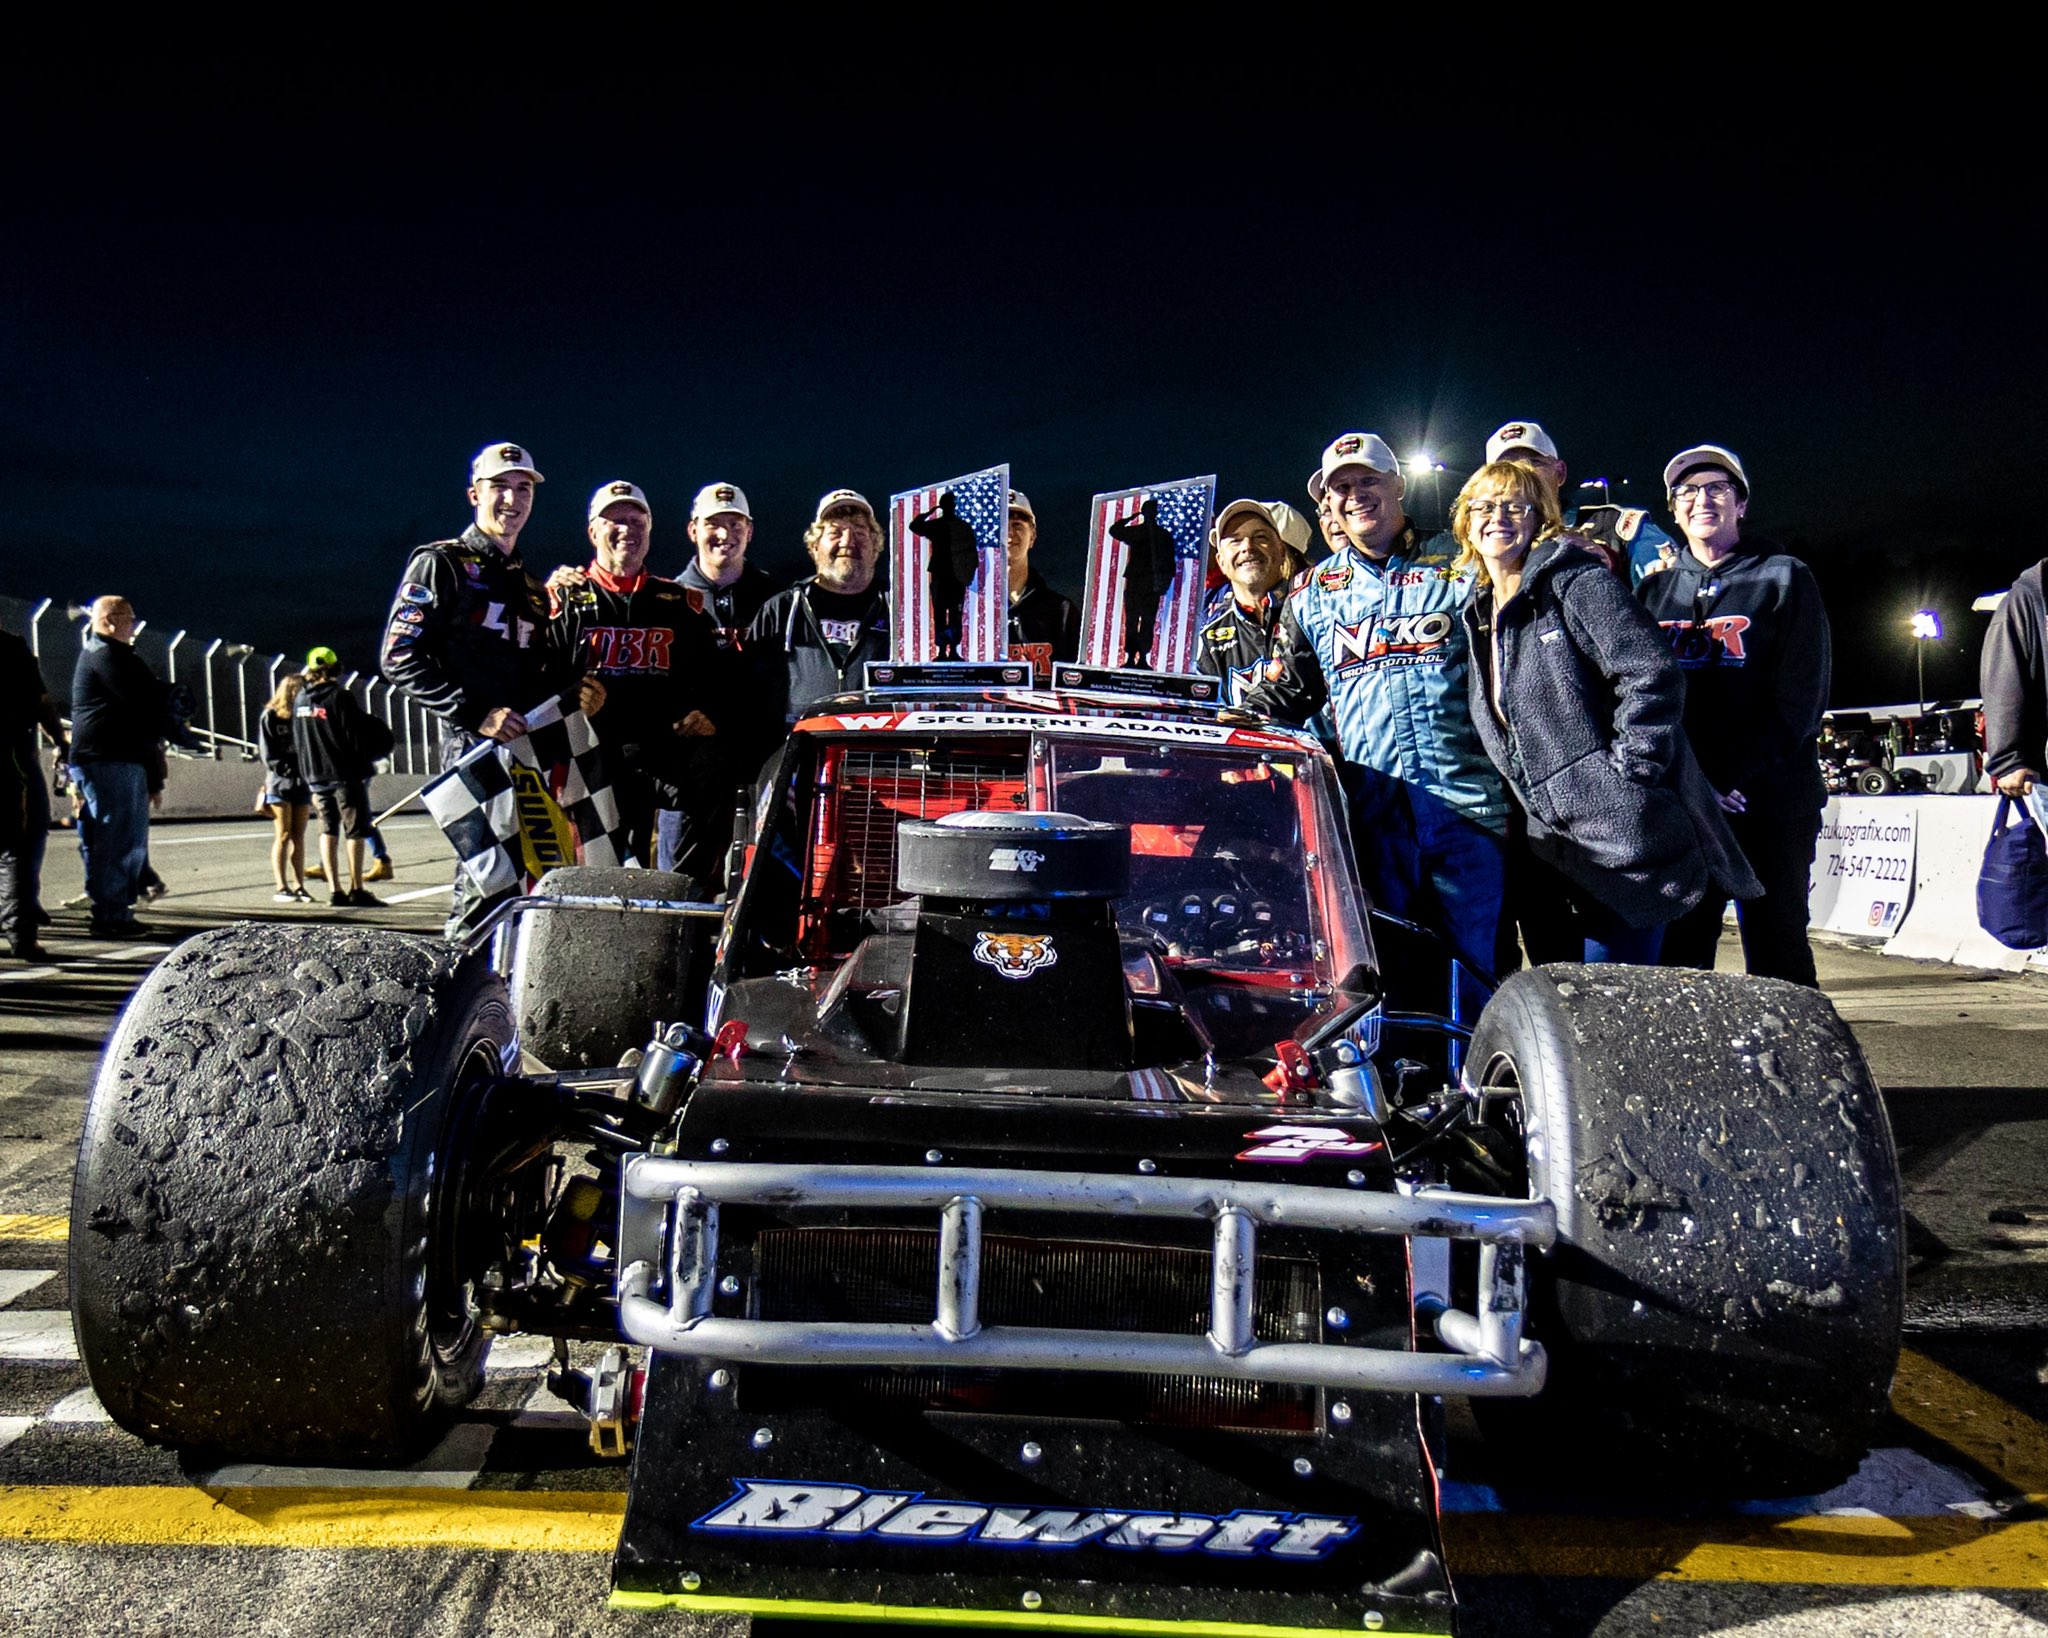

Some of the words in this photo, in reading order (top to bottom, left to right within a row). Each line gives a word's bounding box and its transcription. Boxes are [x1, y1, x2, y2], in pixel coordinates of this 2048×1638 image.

[580, 627, 675, 669] TBR
[1341, 663, 1376, 680] RADIO
[1379, 654, 1445, 669] CONTROL
[917, 715, 975, 725] SFC
[985, 716, 1095, 728] BRENT
[1104, 720, 1223, 738] ADAMS
[1826, 854, 1907, 881] 724-547-2222
[692, 1479, 1361, 1558] Blewett
